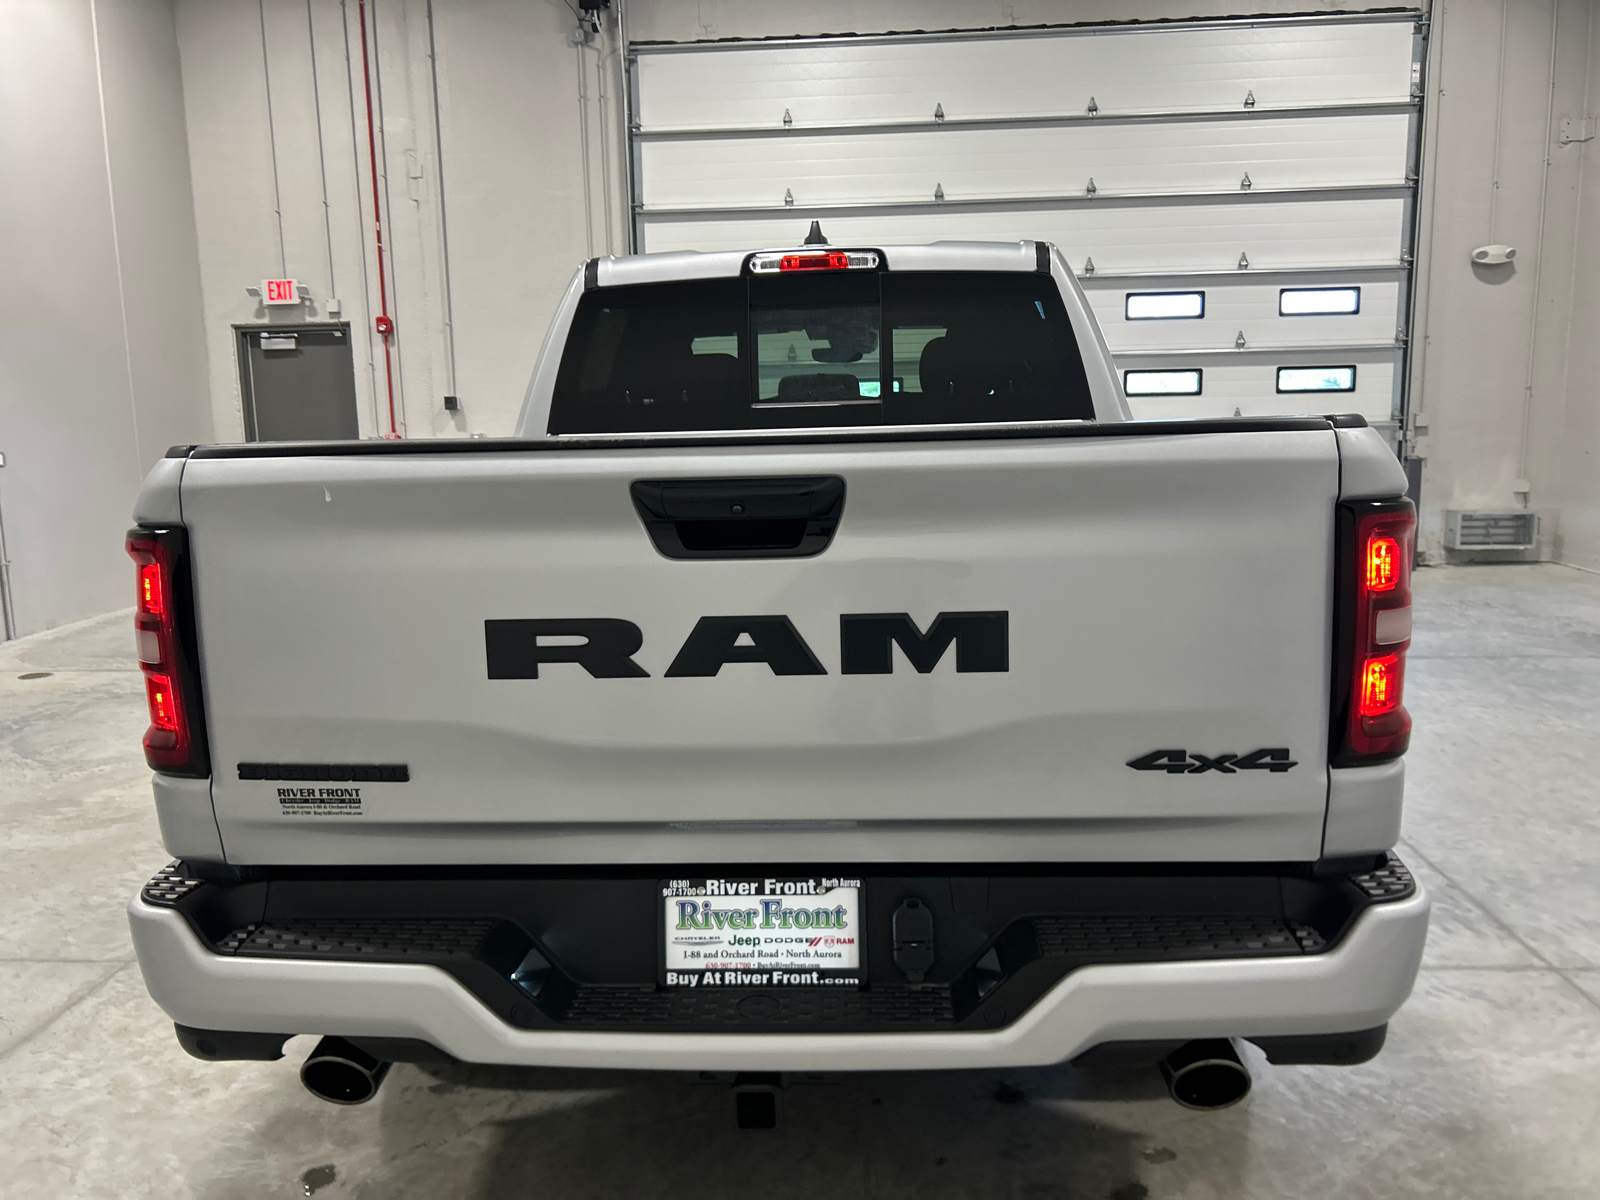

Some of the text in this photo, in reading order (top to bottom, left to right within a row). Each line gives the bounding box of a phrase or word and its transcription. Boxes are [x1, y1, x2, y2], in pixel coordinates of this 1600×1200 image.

[267, 280, 293, 301] EXIT
[484, 610, 1010, 680] RAM
[1125, 747, 1299, 774] 4x4
[277, 788, 361, 797] RIVER FRONT
[669, 879, 690, 888] (630)
[706, 879, 816, 895] River Front
[821, 878, 861, 887] North Aurora
[662, 887, 697, 896] 907-1700
[676, 899, 848, 929] River Front
[728, 934, 761, 947] Jeep
[683, 949, 842, 959] I-88 and Orchard Road North Aurora
[705, 961, 751, 969] 630-907-1700
[666, 971, 699, 987] Buy
[702, 971, 721, 985] At
[724, 971, 769, 985] River
